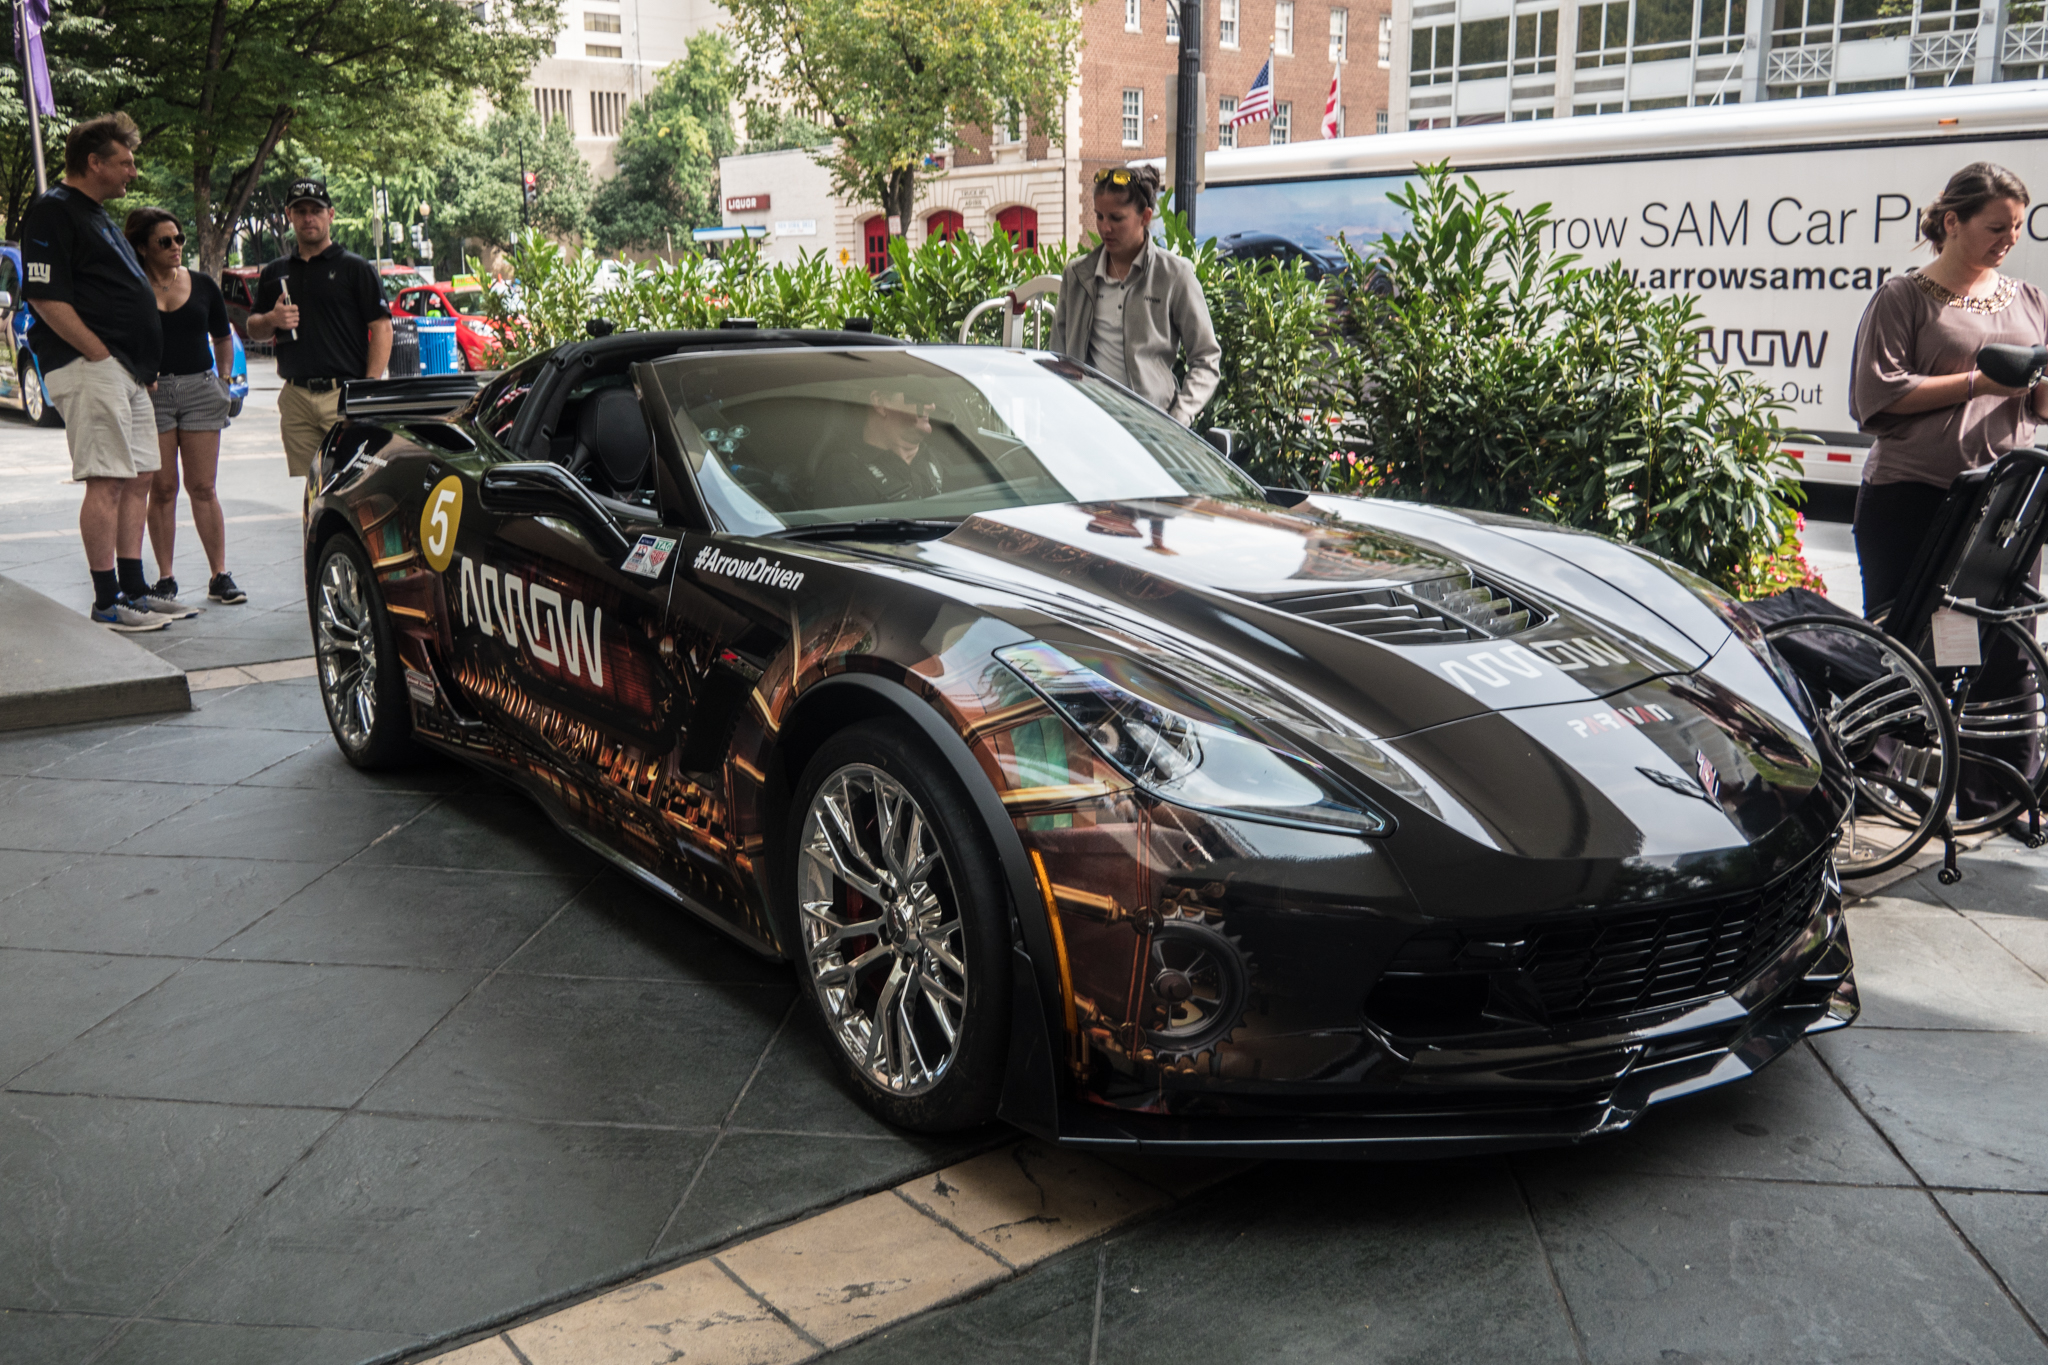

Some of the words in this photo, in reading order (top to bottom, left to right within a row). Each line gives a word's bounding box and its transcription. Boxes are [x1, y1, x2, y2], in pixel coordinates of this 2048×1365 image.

[728, 198, 757, 211] LIQUOR
[1640, 199, 1749, 248] SAM
[1768, 197, 1857, 246] Car
[1680, 329, 1829, 369] RROW
[1781, 382, 1823, 405] Out
[428, 489, 457, 556] 5
[656, 541, 674, 551] TAG
[693, 545, 805, 591] #ArrowDriven
[461, 556, 604, 688] ARROW
[1440, 636, 1630, 695] ARROW
[1567, 703, 1674, 738] PARAVAN
